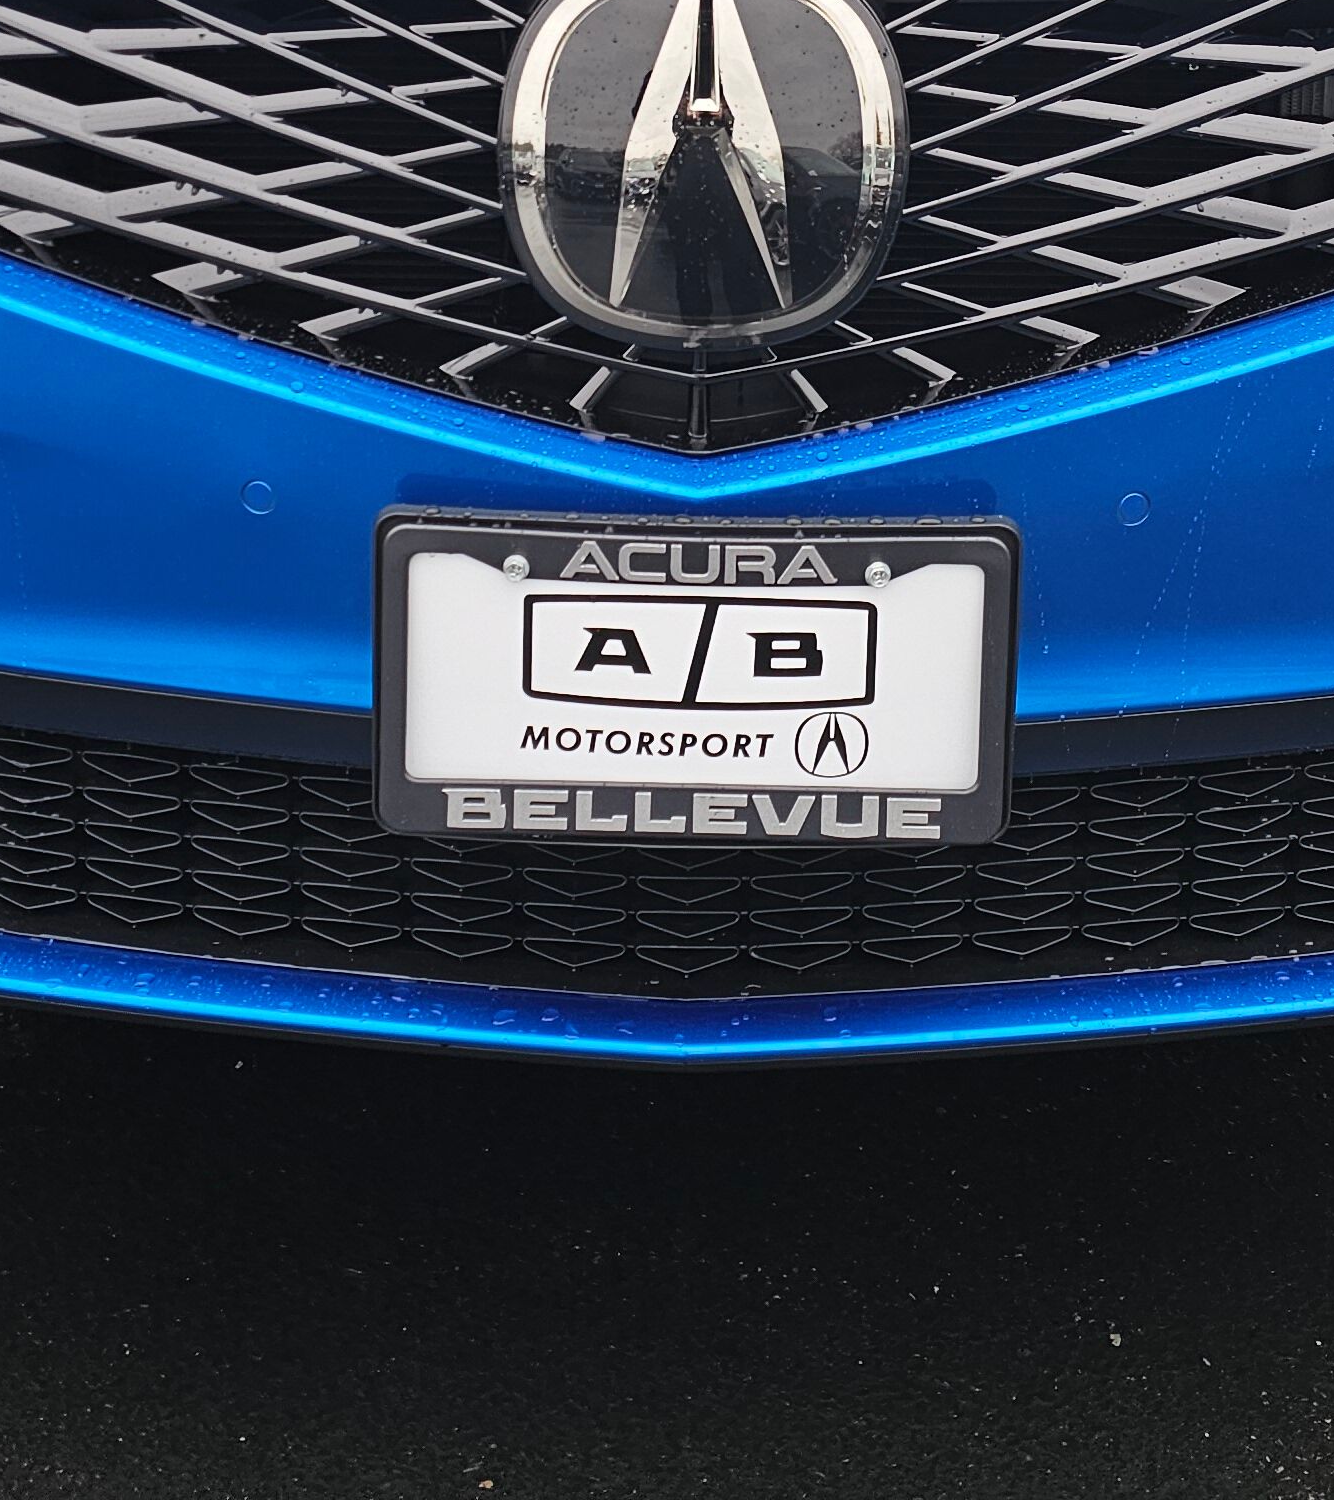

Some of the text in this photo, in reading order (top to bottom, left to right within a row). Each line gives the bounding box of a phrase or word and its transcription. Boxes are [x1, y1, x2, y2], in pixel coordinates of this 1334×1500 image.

[559, 540, 839, 586] ACURA
[574, 627, 824, 678] A B
[520, 724, 774, 760] MOTORSPORT
[441, 786, 942, 841] BELLEVUE
